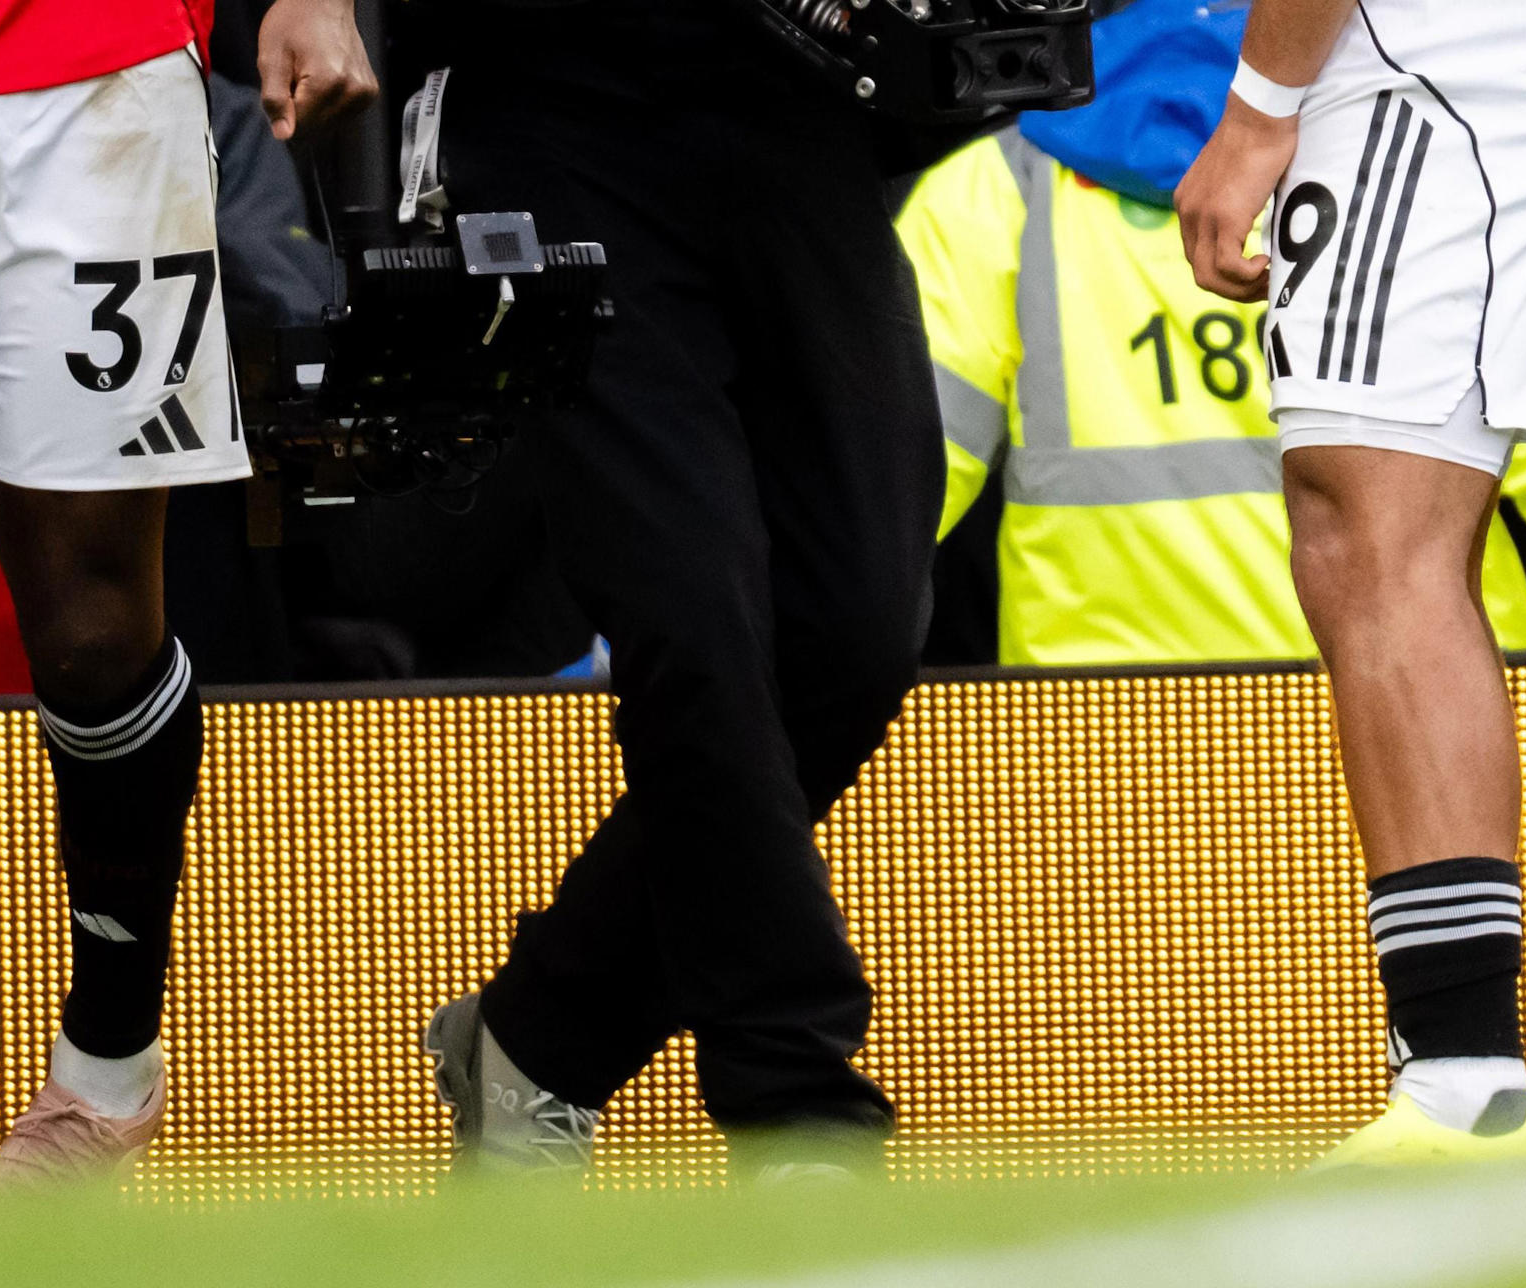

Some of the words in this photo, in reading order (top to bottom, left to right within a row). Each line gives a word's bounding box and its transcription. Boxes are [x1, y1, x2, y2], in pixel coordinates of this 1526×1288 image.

[1272, 181, 1338, 308] 9
[65, 249, 216, 393] 37
[1130, 308, 1267, 405] 18
